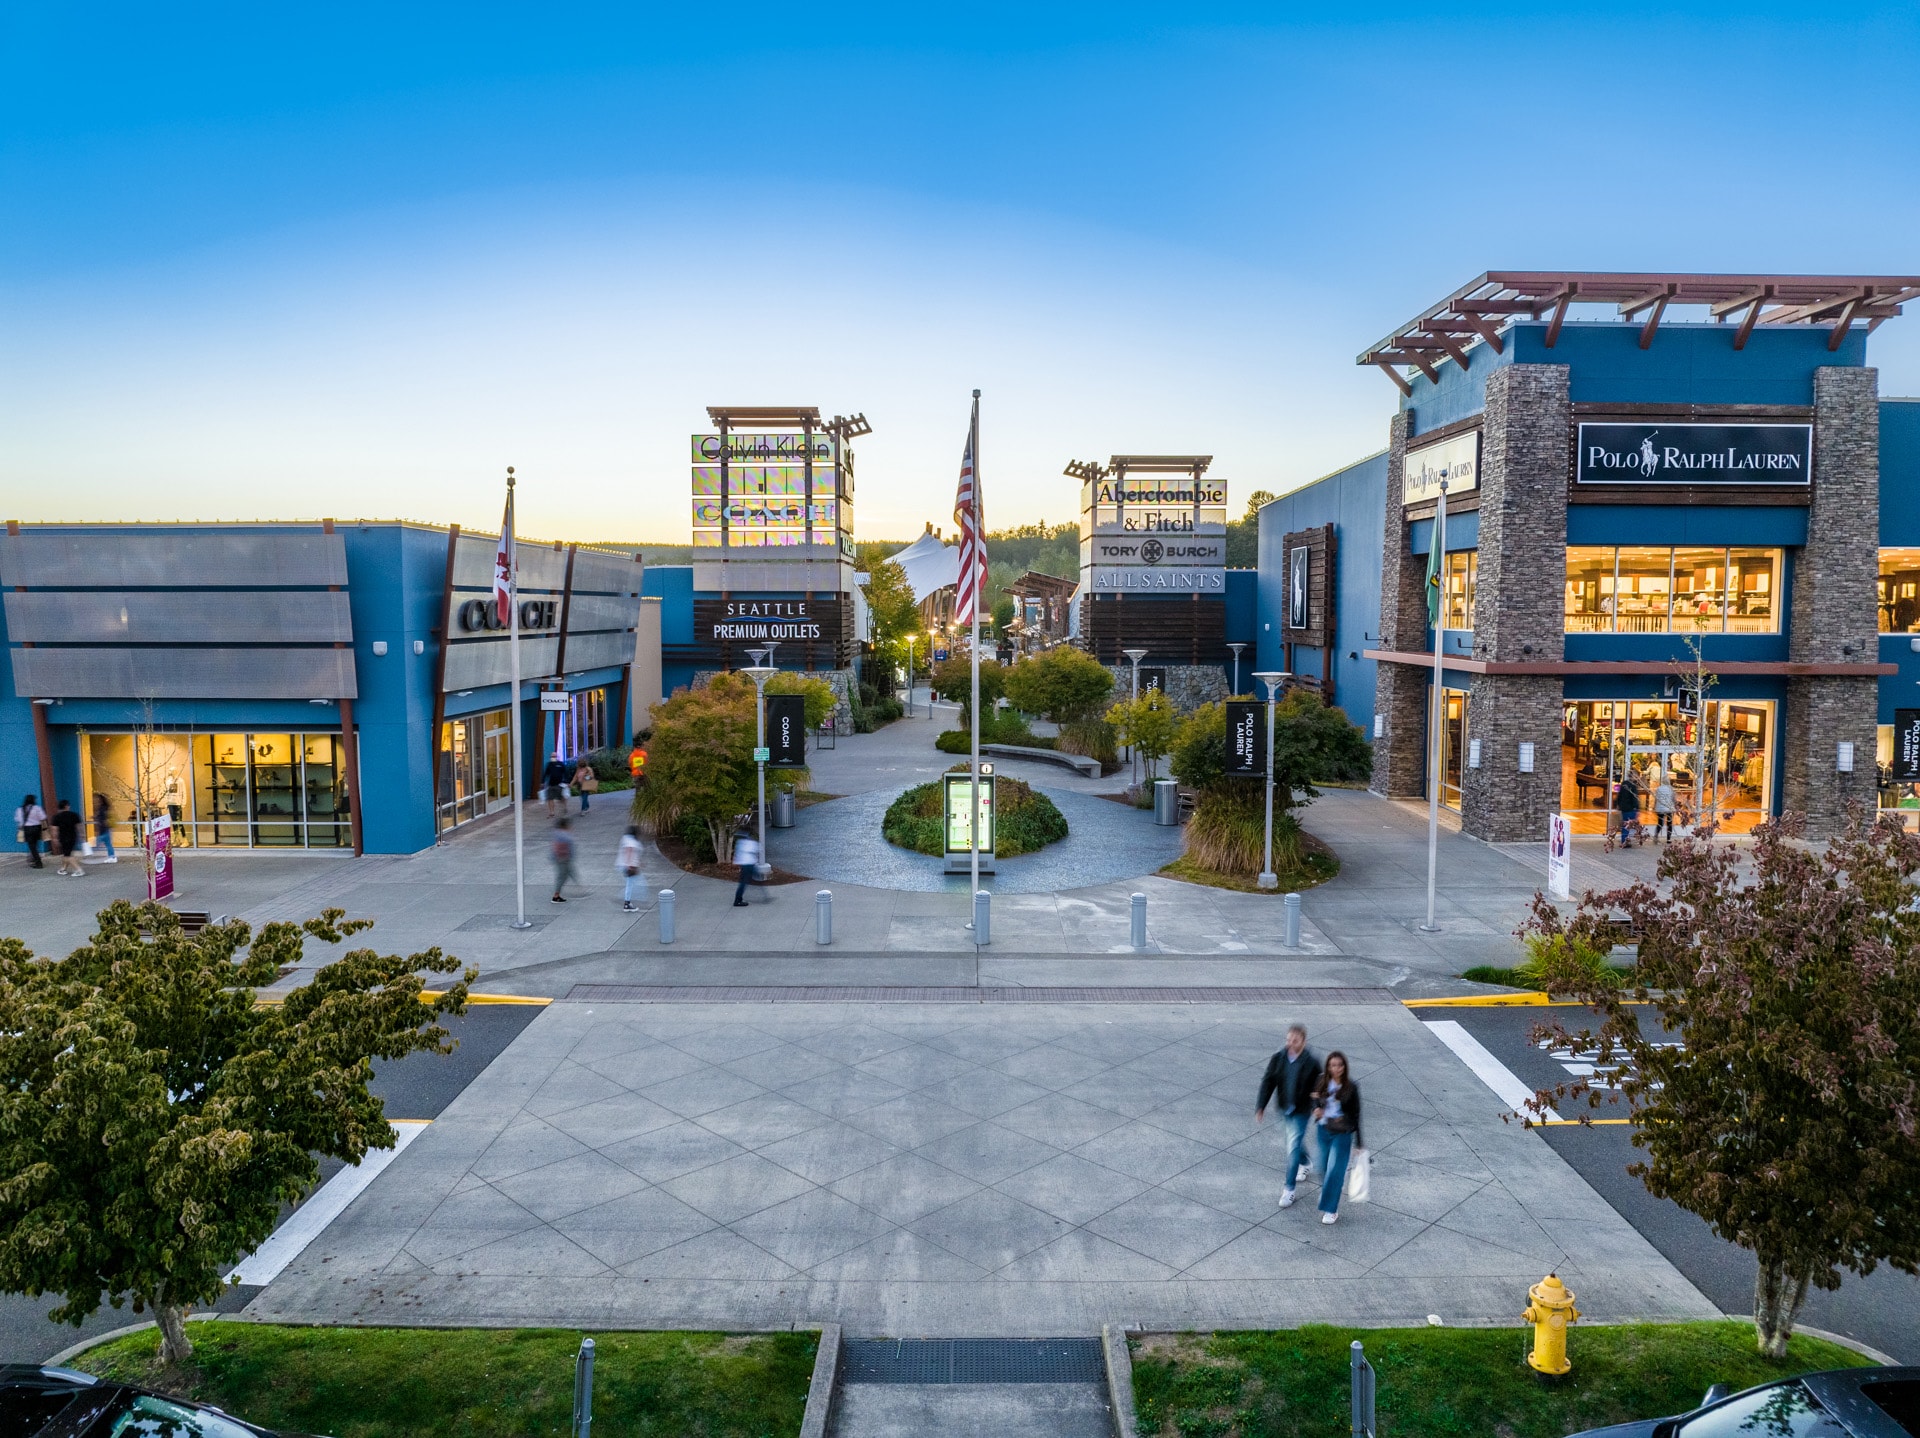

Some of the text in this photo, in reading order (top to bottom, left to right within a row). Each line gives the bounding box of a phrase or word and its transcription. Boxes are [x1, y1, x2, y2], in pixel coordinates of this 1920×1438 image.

[701, 437, 829, 459] Calvin Klein
[1098, 483, 1222, 503] Abercrombie
[697, 504, 834, 521] COACH
[1124, 512, 1194, 532] & Fitch
[1101, 546, 1217, 557] TORY BURCH
[1095, 573, 1221, 588] ALLSAINTS
[727, 603, 806, 615] SEATTLE
[713, 624, 820, 639] PREMIUM OUTLETS
[1236, 722, 1245, 755] LAUREN
[1245, 713, 1254, 765] POLO RALPH
[1903, 730, 1911, 762] LAUREN
[1911, 720, 1920, 771] POLO RALPH
